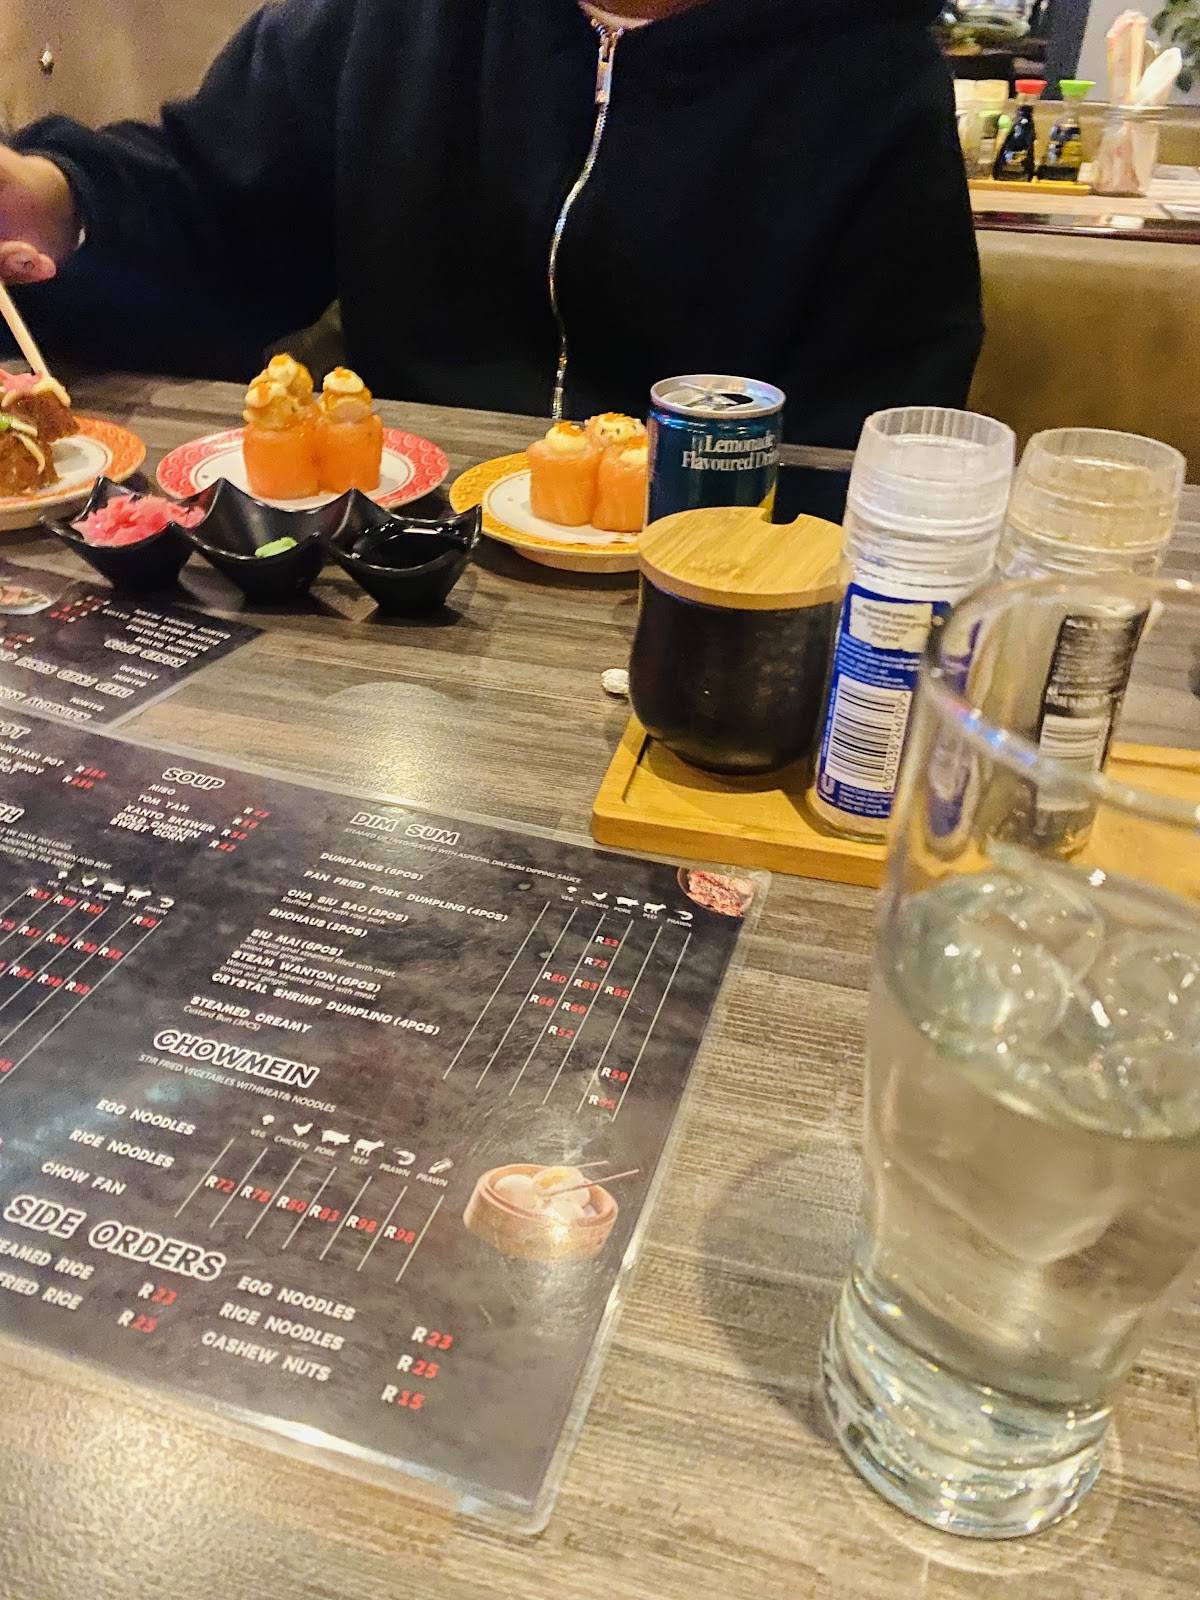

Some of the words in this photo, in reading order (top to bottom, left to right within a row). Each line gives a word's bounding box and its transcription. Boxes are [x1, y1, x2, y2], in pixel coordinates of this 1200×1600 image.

[682, 451, 753, 470] Flavoured
[148, 784, 176, 796] MISO
[162, 767, 225, 790] SOUP
[124, 804, 164, 820] KANTO
[138, 794, 160, 806] TOM
[166, 802, 190, 813] YAM
[350, 812, 399, 832] DIM
[405, 824, 460, 845] SUM
[303, 870, 331, 882] PAN
[333, 876, 366, 890] FRIED
[369, 885, 402, 898] PORK
[406, 893, 466, 912] DUMPLING
[226, 959, 256, 971] Wanton
[257, 966, 278, 977] wrap
[278, 973, 312, 985] steamed
[335, 985, 353, 995] with
[232, 950, 274, 968] STEAM
[280, 962, 337, 982] WANTON
[354, 962, 374, 971] with
[183, 1005, 218, 1020] Custard
[190, 996, 251, 1018] STEAMED
[255, 1013, 312, 1034] CREAMY
[212, 973, 268, 994] CRYSTAL
[273, 988, 323, 1006] SHRIMP
[326, 1000, 393, 1025] DUMPLING
[548, 1025, 575, 1039] R52
[153, 1029, 320, 1089] CHOWMEIN
[158, 1059, 183, 1072] FRIED
[184, 1066, 236, 1087] VEGETABLES
[291, 1094, 336, 1113] NOODLES
[96, 1098, 127, 1115] EGG
[129, 1108, 196, 1136] NOODLES
[69, 1128, 105, 1148] RICE
[107, 1140, 175, 1168] NOODLES
[274, 1135, 310, 1150] CHICKEN
[379, 1163, 411, 1178] PRAWN
[416, 1173, 449, 1187] PRAWN
[41, 1161, 90, 1184] CHOW
[91, 1176, 127, 1195] FAN
[205, 1175, 236, 1194] R72
[3, 1195, 87, 1239] SIDE
[88, 1220, 227, 1281] ORDERS
[54, 1256, 95, 1280] RICE
[42, 1286, 83, 1311] RICE
[236, 1275, 273, 1296] EGG
[277, 1287, 356, 1321] NOODLES
[219, 1302, 261, 1326] RICE
[264, 1316, 345, 1350] NOODLES
[201, 1331, 280, 1364] CASHEW
[281, 1355, 332, 1382] NUTS
